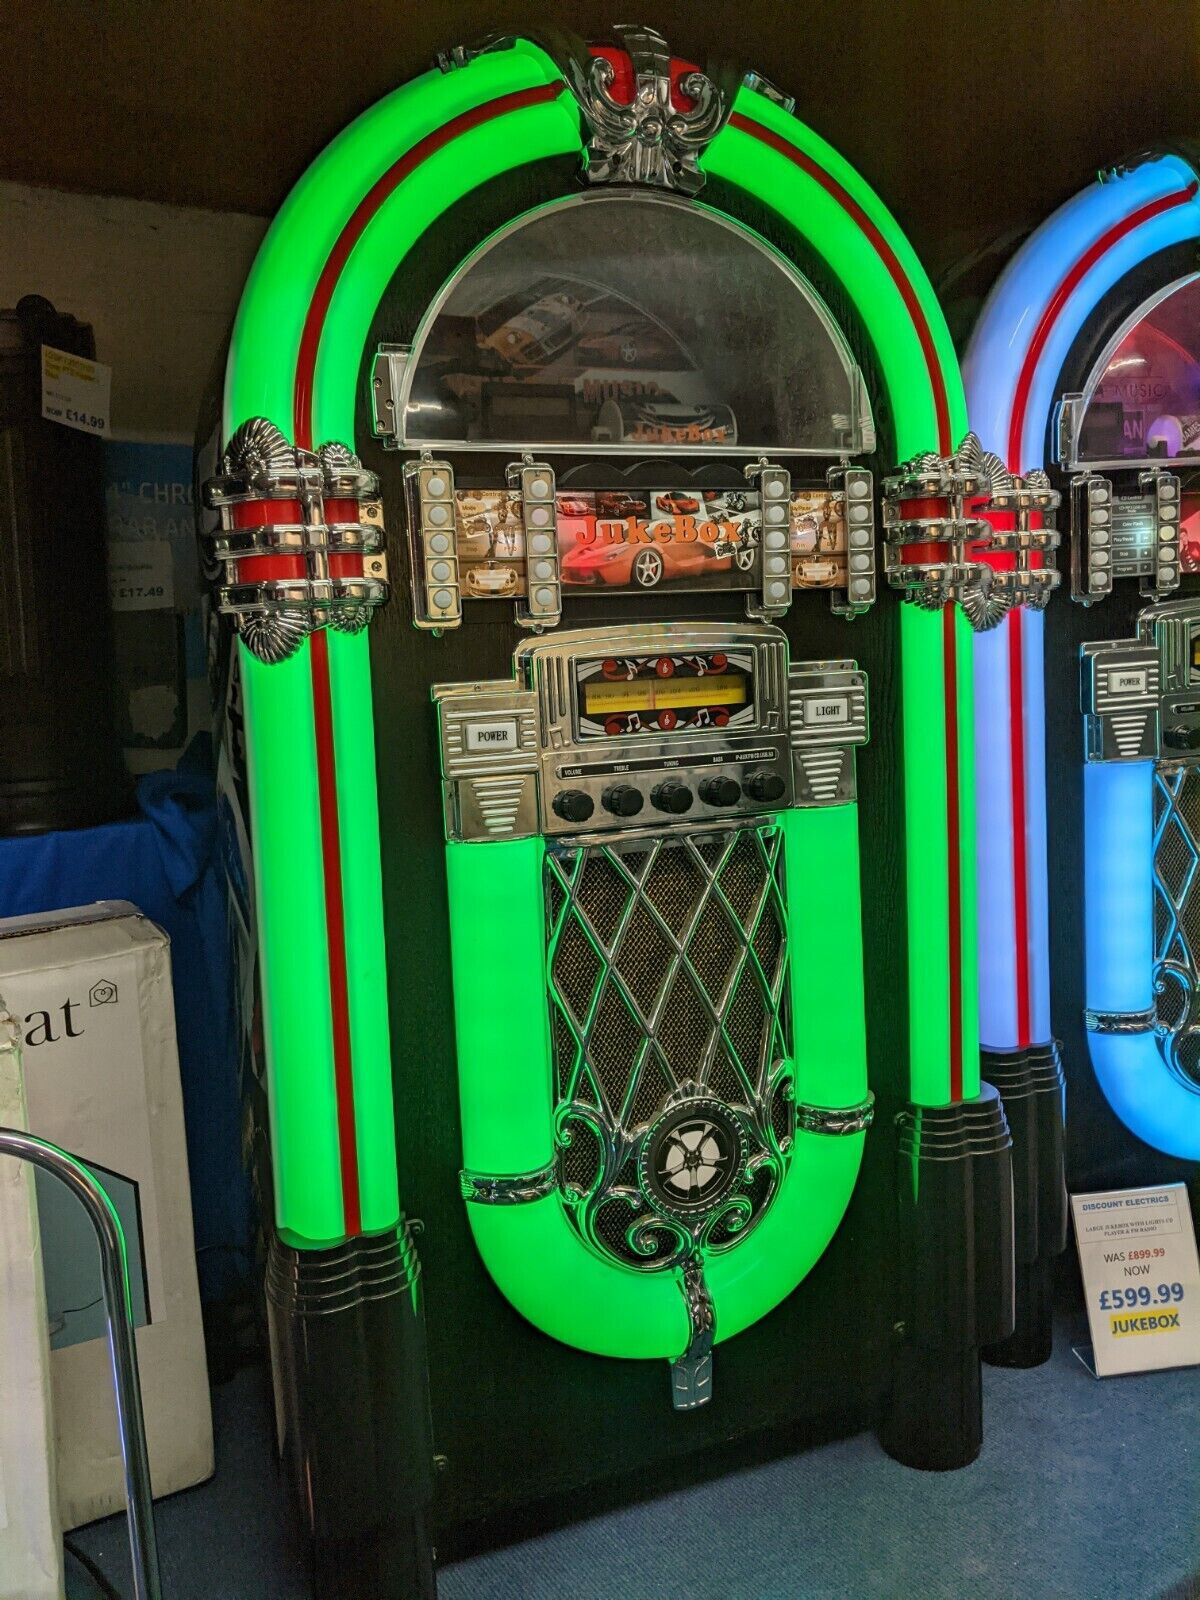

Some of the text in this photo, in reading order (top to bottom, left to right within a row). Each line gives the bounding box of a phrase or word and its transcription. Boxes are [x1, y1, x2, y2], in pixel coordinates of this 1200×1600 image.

[66, 409, 105, 429] £14.99
[575, 515, 743, 545] JukeBox
[1119, 677, 1141, 687] POWER
[815, 705, 840, 716] LIGHT
[477, 730, 508, 742] POWER
[564, 768, 582, 776] VOLUME
[1082, 1195, 1169, 1211] DISCOUNT ELECTRICS
[1085, 1224, 1104, 1233] LARGE
[1104, 1221, 1129, 1230] JUKEBOX
[1130, 1220, 1145, 1228] WITH
[1104, 1228, 1125, 1237] PLAYER
[1140, 1225, 1157, 1233] RADIO
[1103, 1247, 1166, 1264] WAS £899.99
[1123, 1264, 1151, 1277] NOW
[1098, 1283, 1184, 1311] £599.99
[1111, 1313, 1181, 1335] JUKEBOX
